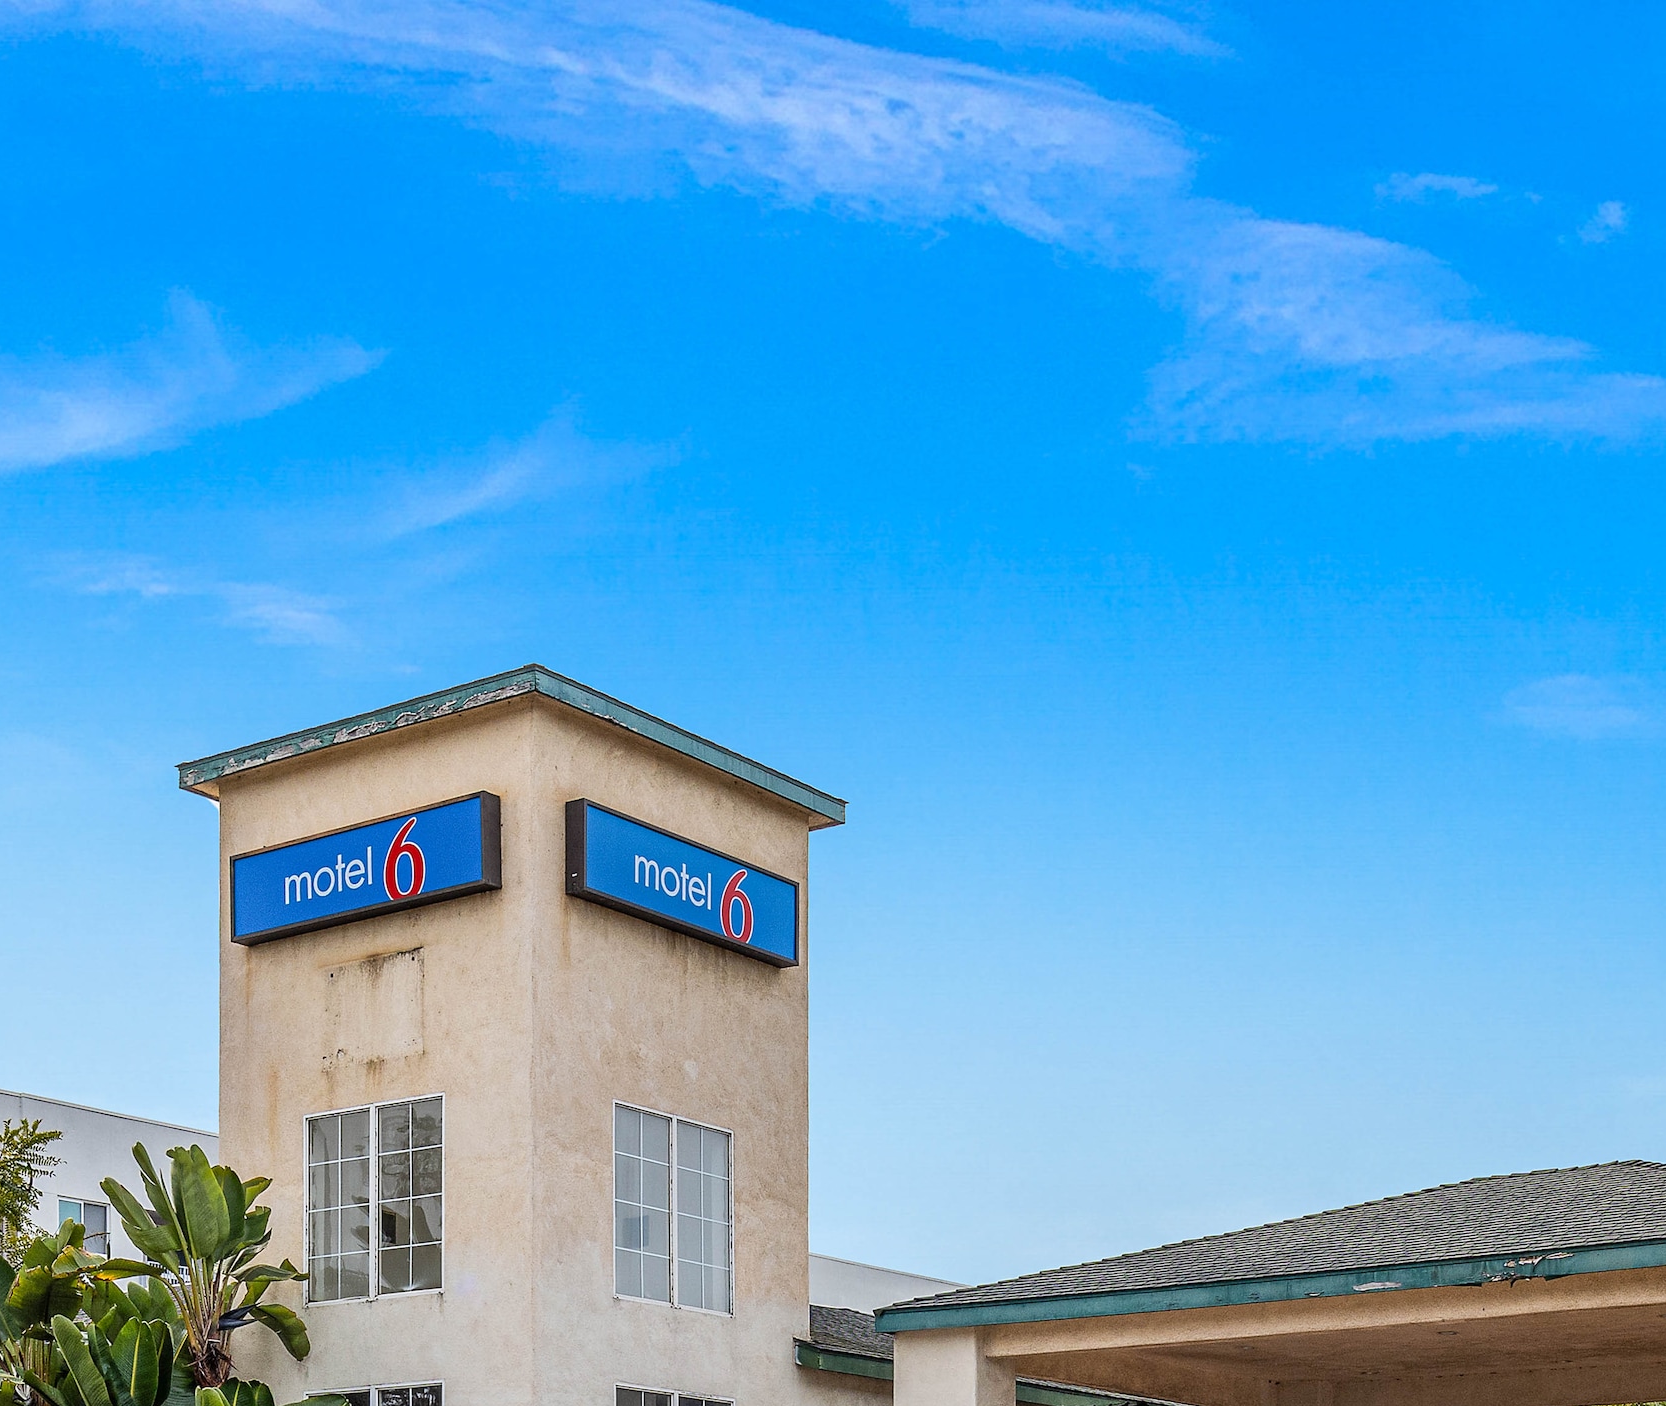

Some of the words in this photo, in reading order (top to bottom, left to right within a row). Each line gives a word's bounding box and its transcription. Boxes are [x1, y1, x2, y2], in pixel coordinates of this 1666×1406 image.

[284, 846, 374, 905] motel
[384, 816, 426, 900] 6
[634, 853, 712, 911] motel
[720, 868, 754, 944] 6
